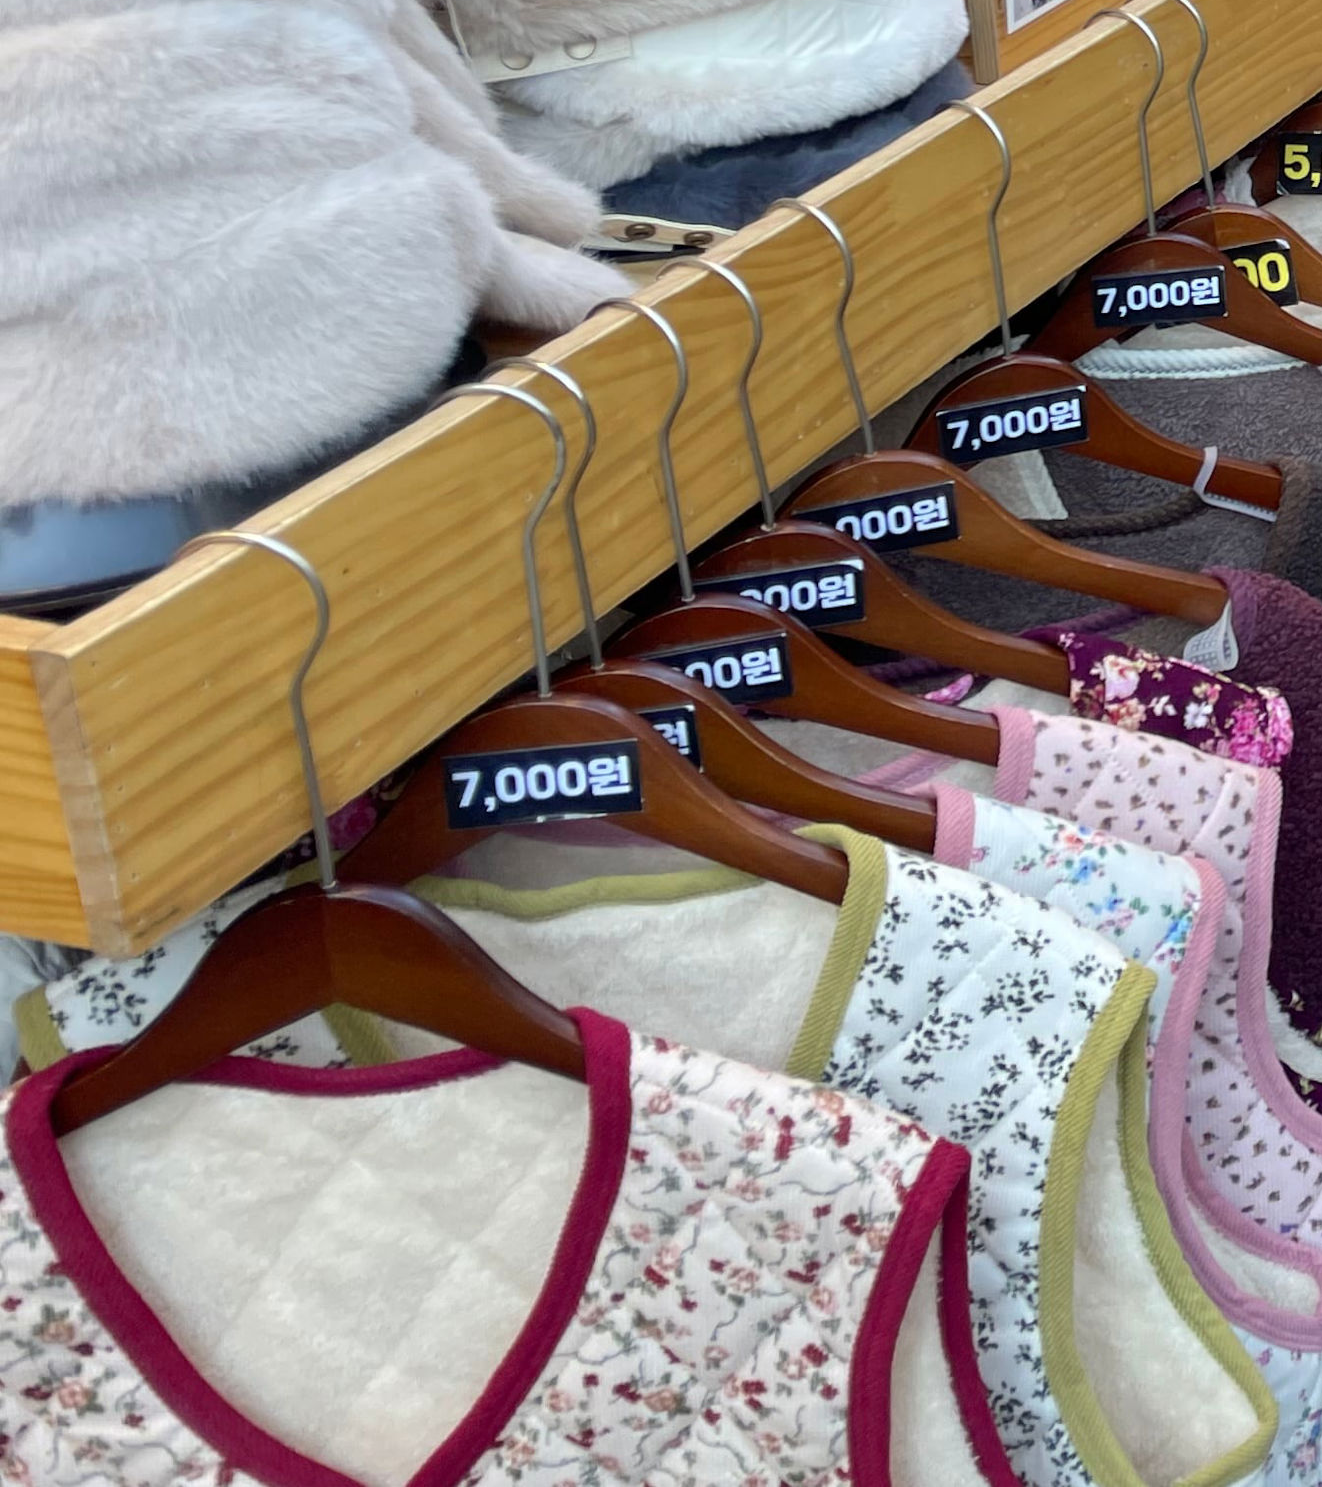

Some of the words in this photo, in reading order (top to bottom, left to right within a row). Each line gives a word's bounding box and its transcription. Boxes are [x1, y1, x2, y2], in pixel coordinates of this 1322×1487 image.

[1096, 275, 1220, 318] 7,000원
[946, 397, 1082, 451] 7,000원
[451, 755, 633, 813] 7,000원
